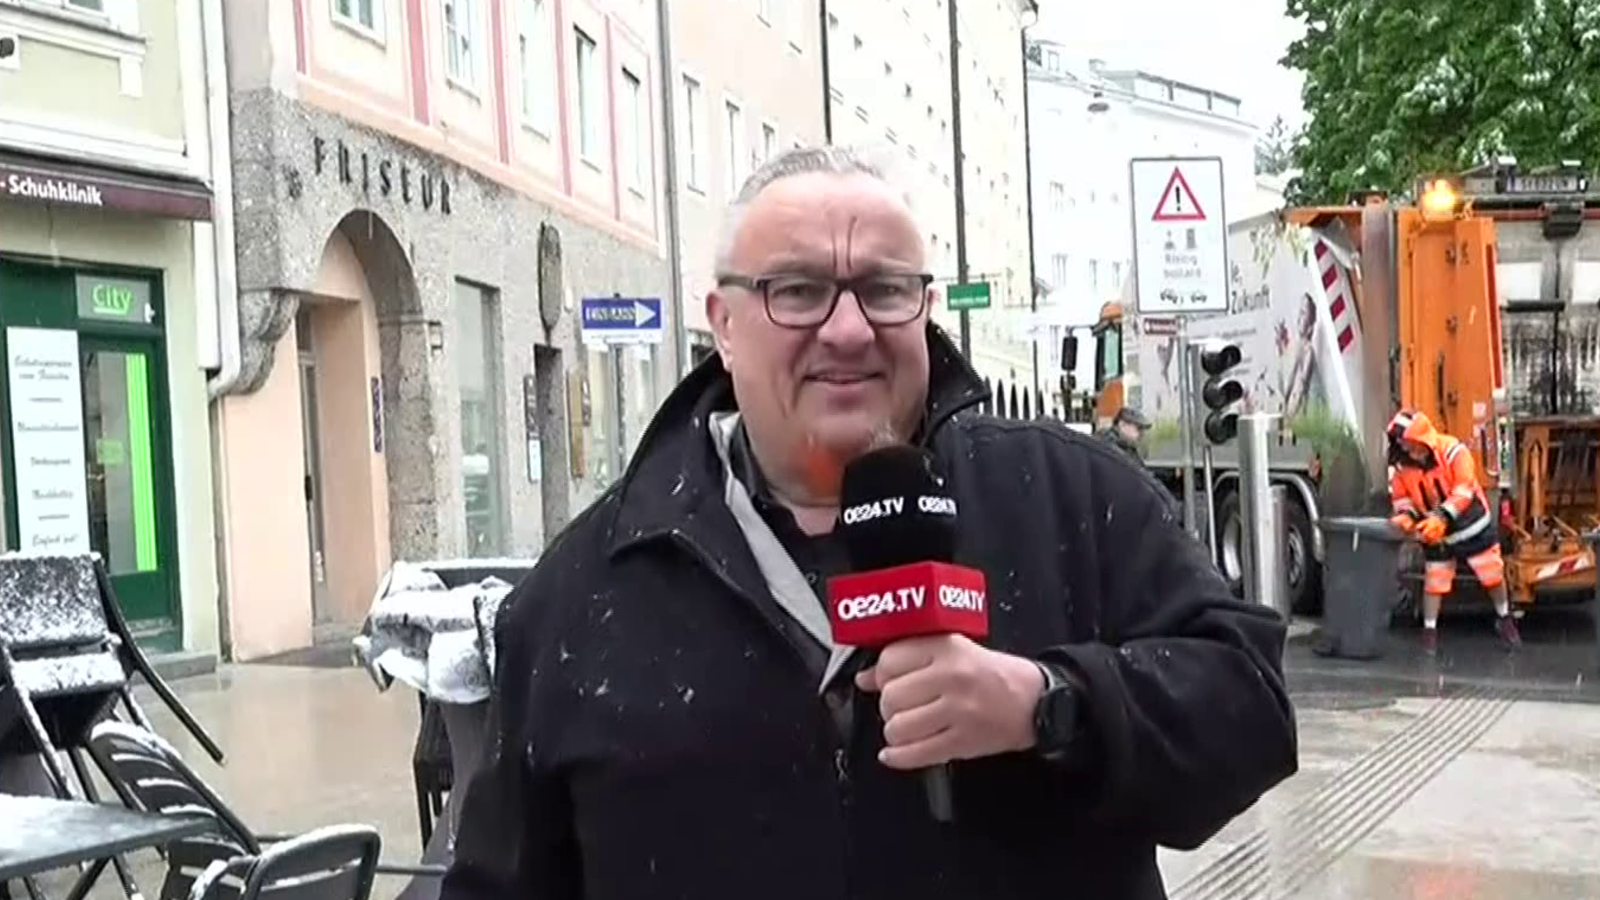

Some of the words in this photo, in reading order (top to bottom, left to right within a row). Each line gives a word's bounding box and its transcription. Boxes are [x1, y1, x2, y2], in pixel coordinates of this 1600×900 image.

[8, 175, 103, 206] Schuhklinik
[314, 137, 451, 215] FRISEUR
[93, 284, 132, 314] City
[1231, 284, 1271, 315] Zukunft
[838, 585, 925, 620] oe24.TV
